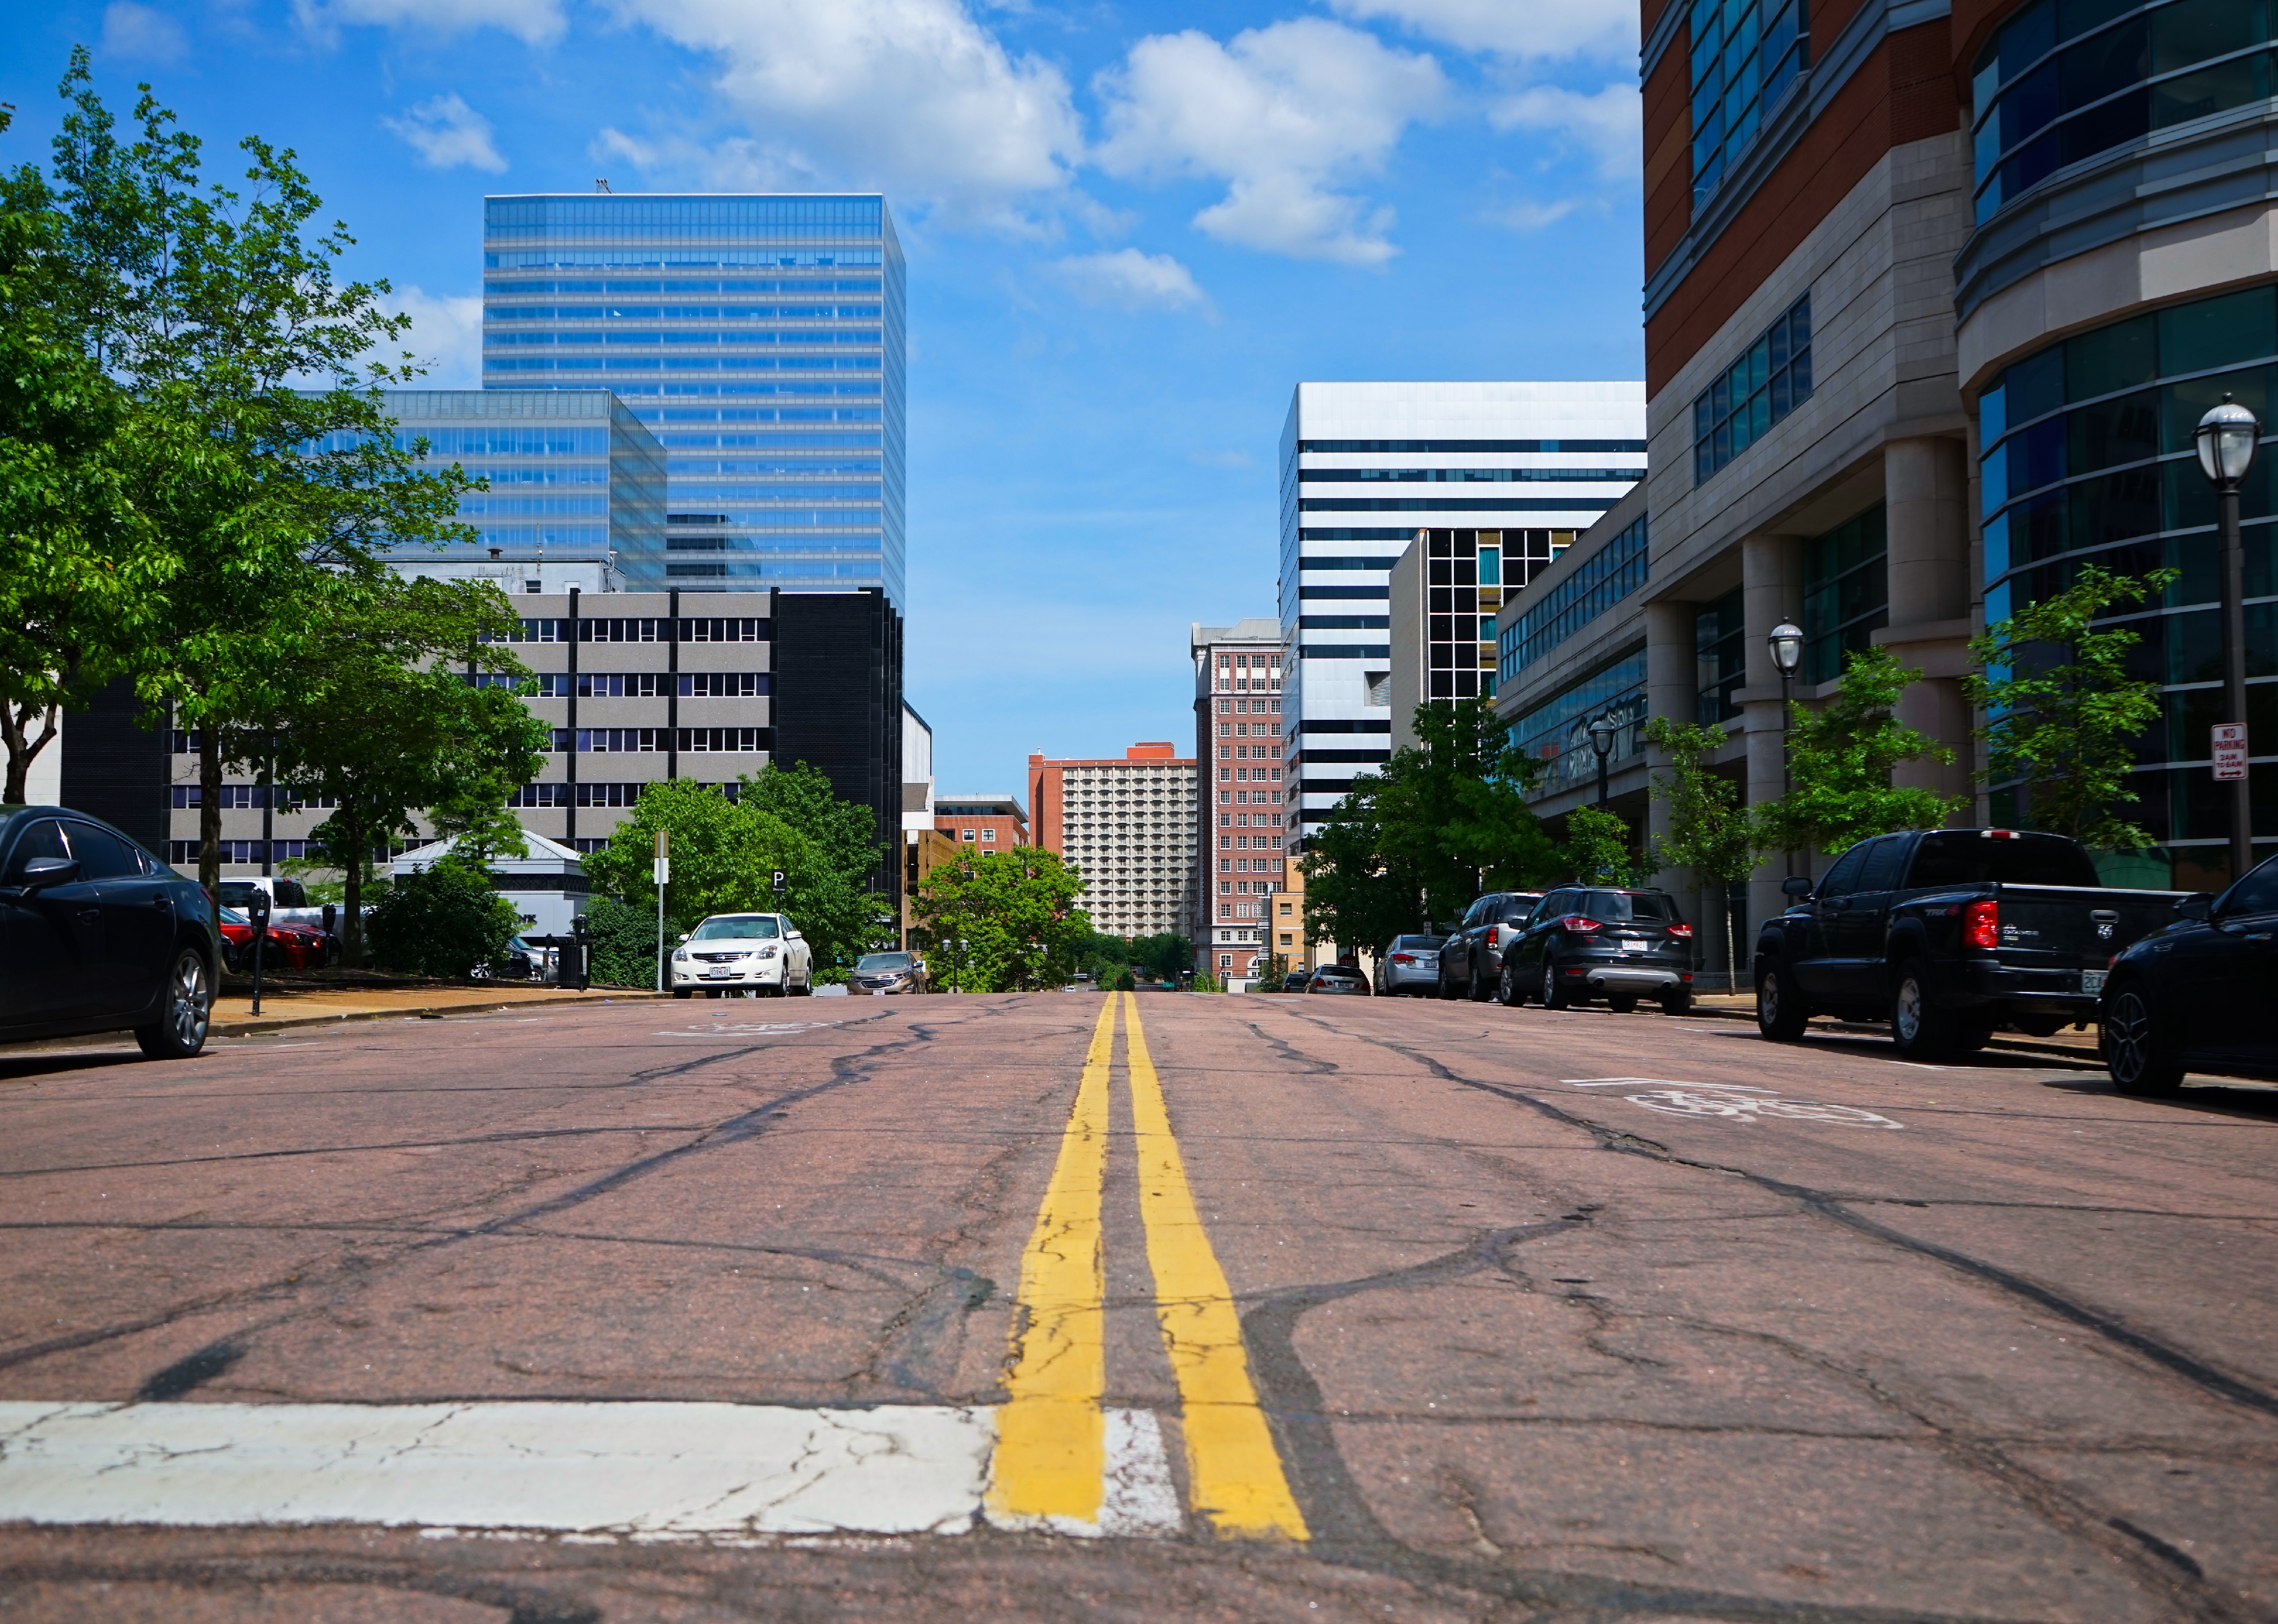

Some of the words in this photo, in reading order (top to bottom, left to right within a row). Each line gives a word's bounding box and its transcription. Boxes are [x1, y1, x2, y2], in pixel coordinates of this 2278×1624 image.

[2223, 728, 2235, 738] NO
[2214, 739, 2244, 750] PARKING
[774, 872, 784, 886] P
